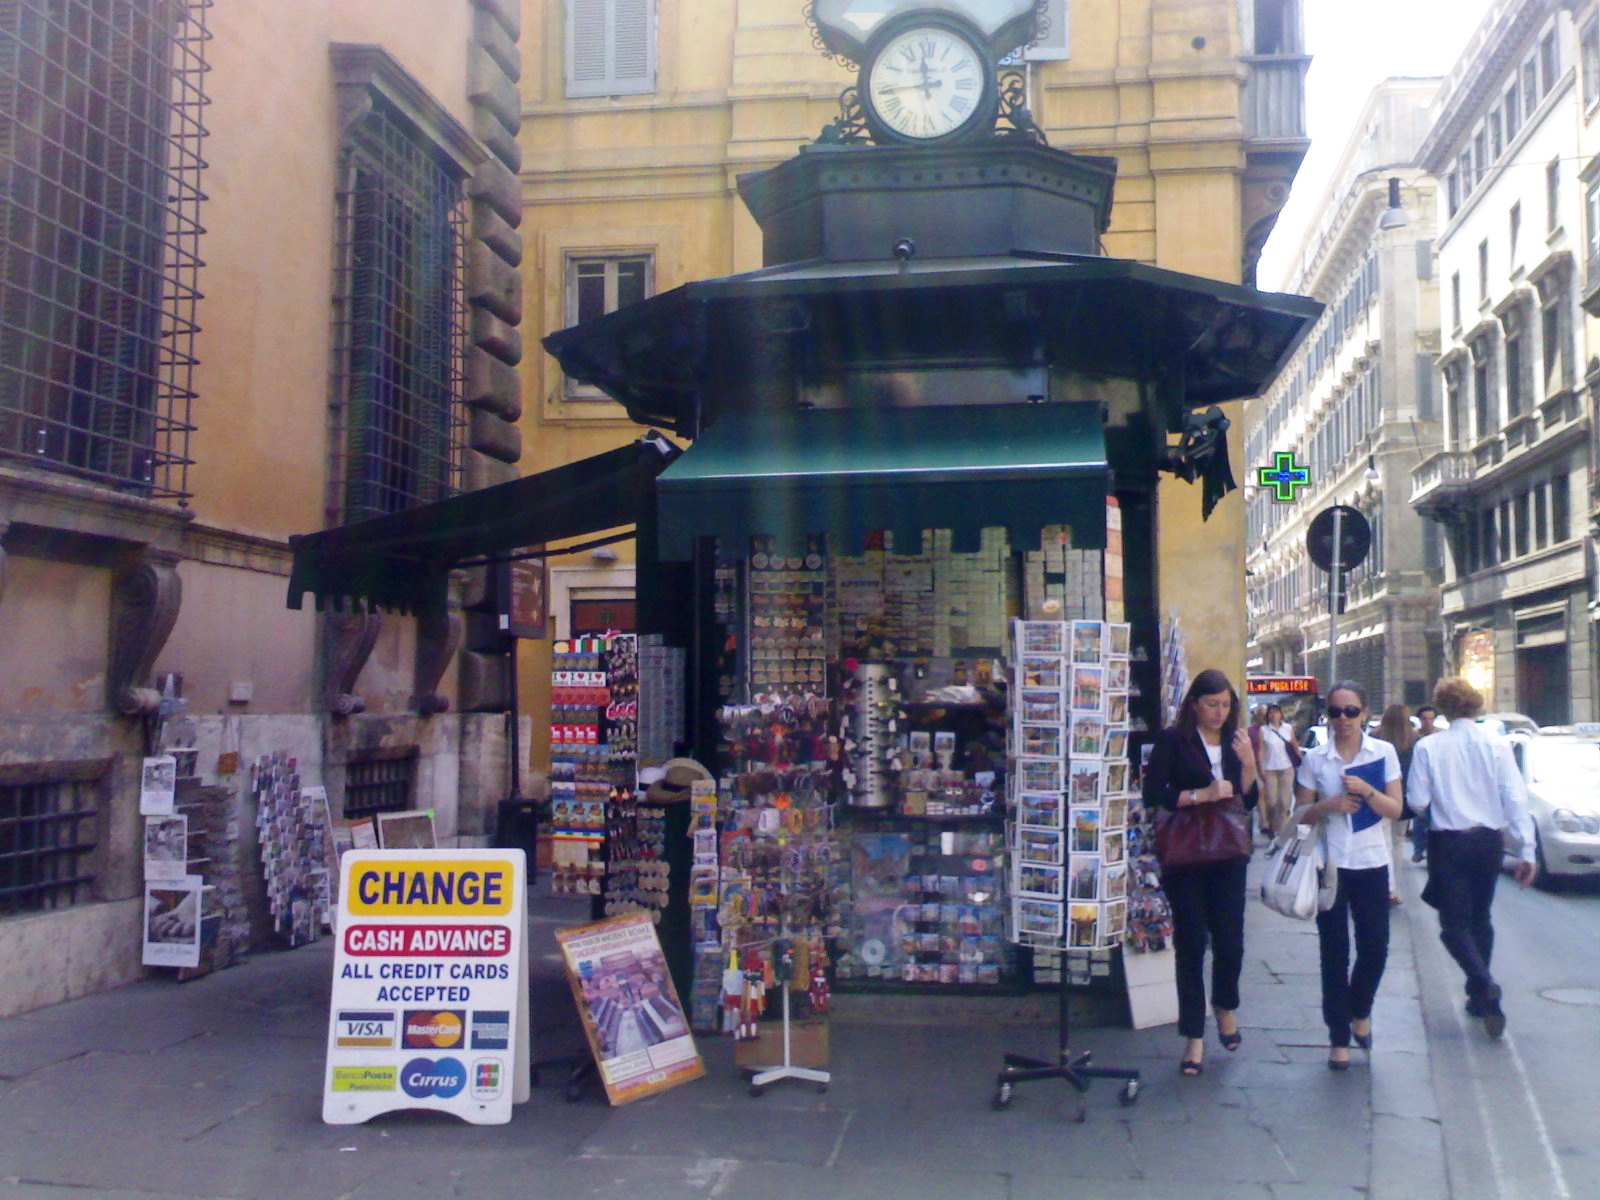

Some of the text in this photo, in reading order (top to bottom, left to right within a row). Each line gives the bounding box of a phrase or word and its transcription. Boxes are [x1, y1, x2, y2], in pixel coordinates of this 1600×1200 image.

[1270, 681, 1309, 691] PUGLIESE
[358, 870, 504, 906] CHANGE
[349, 929, 506, 952] CASH ADVANCE
[341, 963, 509, 979] ALL CREDIT CARDS
[377, 985, 470, 1002] ACCEPTED
[347, 1022, 384, 1036] VISA
[407, 1023, 462, 1036] MasterCard
[408, 1072, 458, 1087] Cirrus
